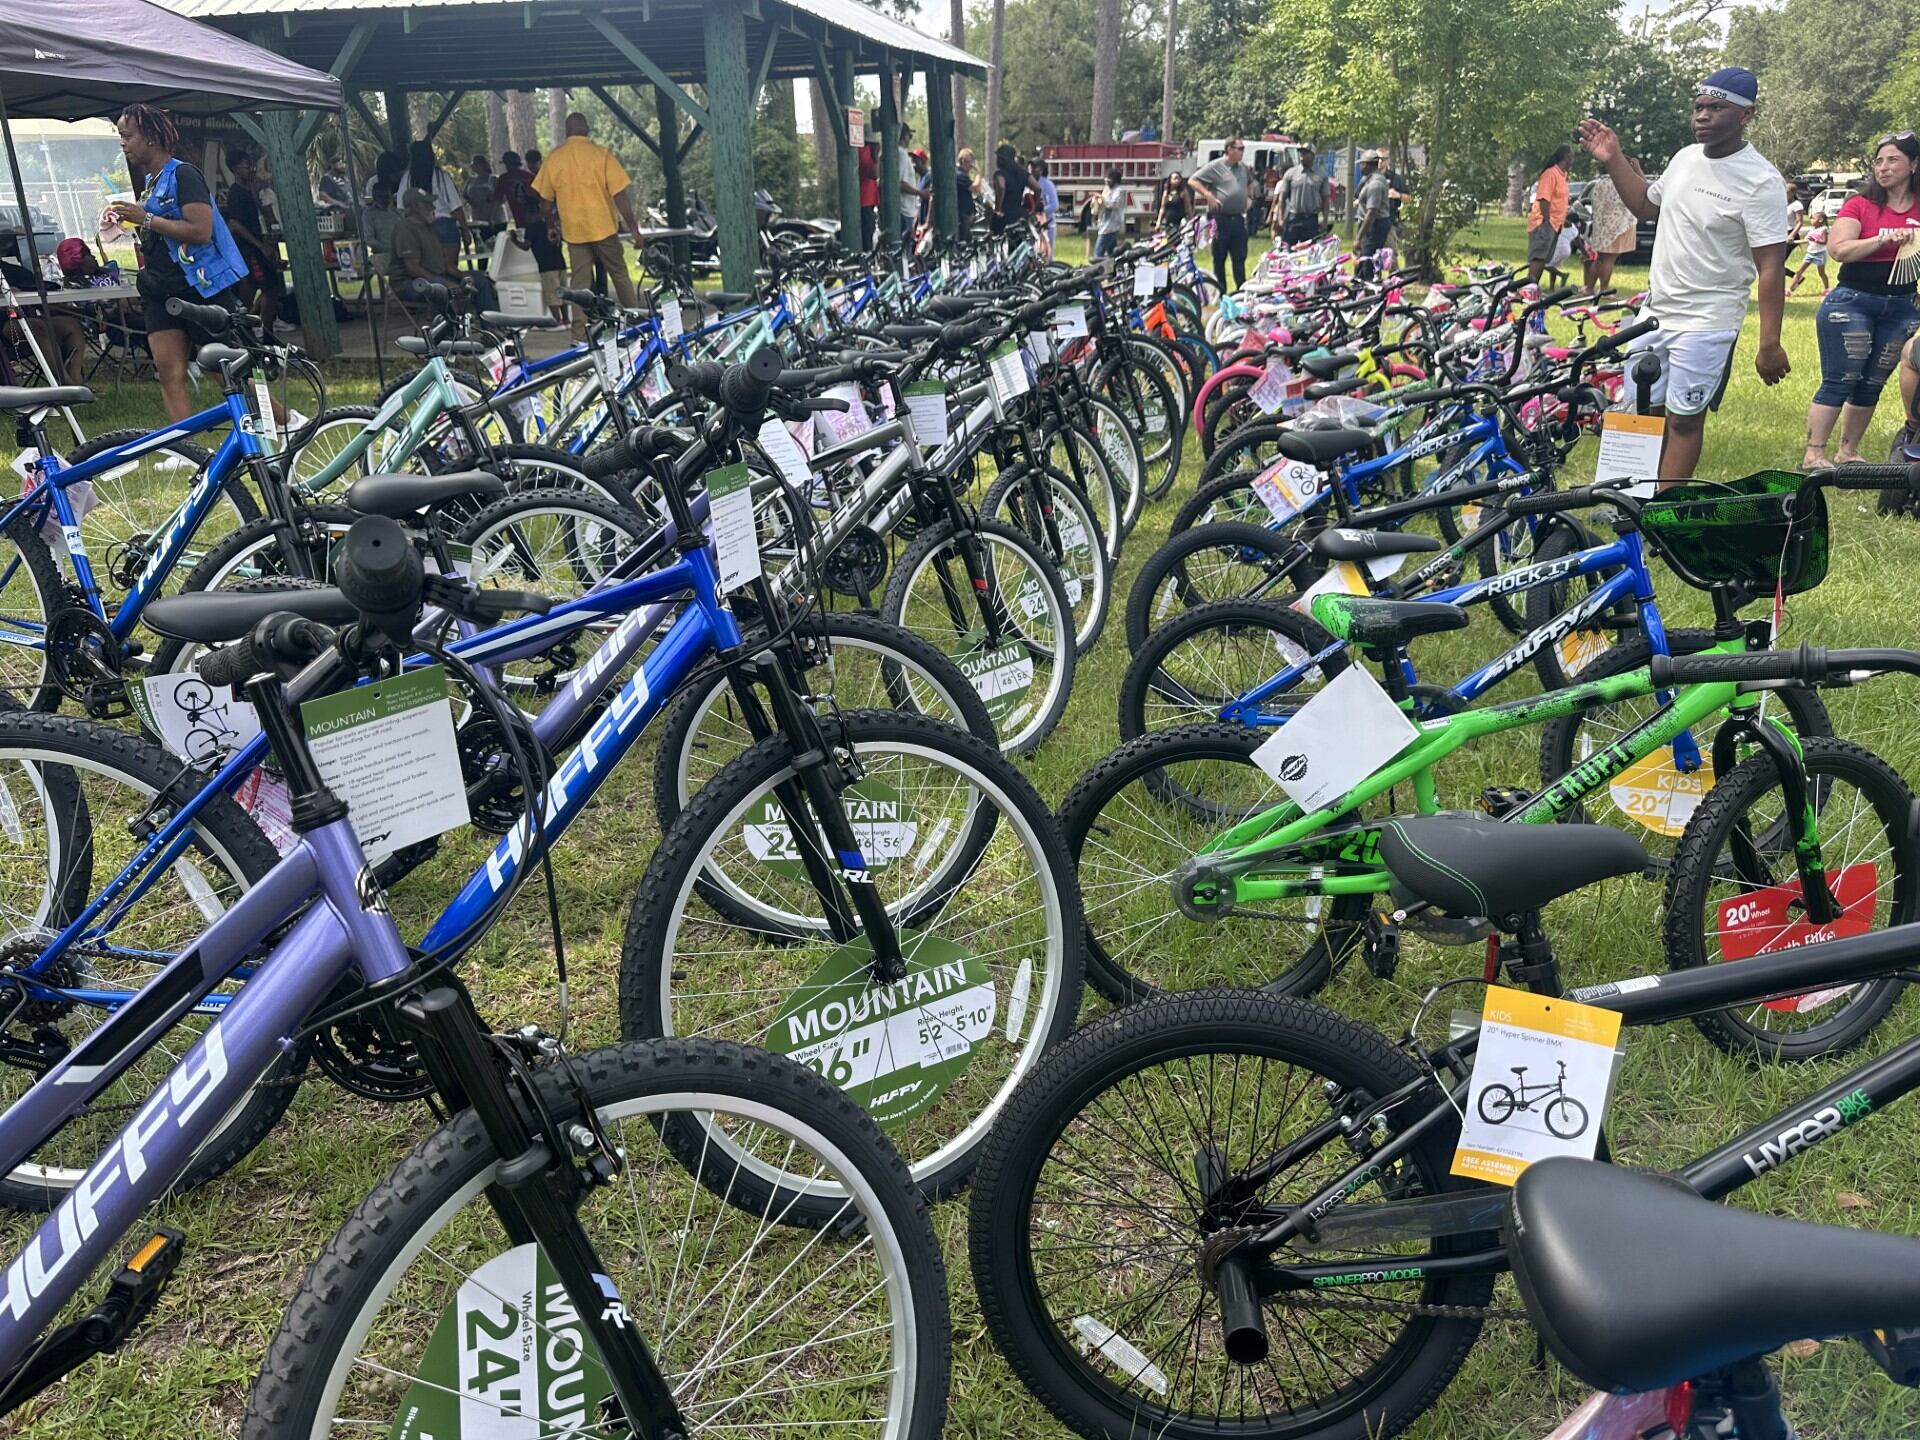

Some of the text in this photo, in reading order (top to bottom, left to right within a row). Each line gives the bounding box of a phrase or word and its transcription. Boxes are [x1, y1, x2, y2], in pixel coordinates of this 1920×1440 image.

[1410, 432, 1464, 460] ROCK IT
[1498, 472, 1530, 490] SPINNER
[137, 471, 210, 595] HUFFY
[1488, 558, 1576, 596] ROCK IT
[1504, 604, 1582, 672] HUFFY
[960, 646, 1020, 678] OUNTAIN
[406, 691, 441, 706] SUSPENSION
[310, 707, 376, 736] MOUNTAIN
[317, 758, 337, 768] Usage:
[339, 752, 354, 762] Keep
[340, 753, 366, 766] light trails
[342, 764, 364, 775] Durable
[384, 753, 397, 761] steel
[396, 748, 412, 758] frame
[414, 751, 437, 762] Shimano
[1282, 756, 1306, 778] Pacific
[349, 791, 364, 800] Front
[364, 787, 375, 795] and
[411, 769, 428, 779] brakes
[486, 664, 650, 893] HUFFY
[1545, 742, 1630, 811] ERUPT
[1657, 775, 1702, 791] KIDS
[379, 792, 394, 801] frame
[1626, 792, 1669, 814] 20"
[379, 812, 400, 823] padded
[1726, 902, 1770, 927] 20" Wheel
[788, 958, 967, 1045] MOUNTAIN
[918, 1006, 964, 1027] Rider Height
[956, 1005, 992, 1032] 5'10"
[1488, 1008, 1513, 1023] KIDS
[1486, 1024, 1562, 1047] 20" Hyper Spinner BMX
[8, 1054, 46, 1069] SHIMANO
[794, 1046, 821, 1062] Wheel
[870, 1080, 923, 1109] HUFFY
[906, 1104, 920, 1114] wear
[1844, 1104, 1872, 1124] CO
[1742, 1088, 1871, 1178] HYPER BIKE
[1462, 1154, 1520, 1173] FREE ASSEMBLY
[1312, 1268, 1426, 1288] SPINNERPROMODEL
[521, 1290, 532, 1362] Wheel Size
[466, 1301, 522, 1418] 24"
